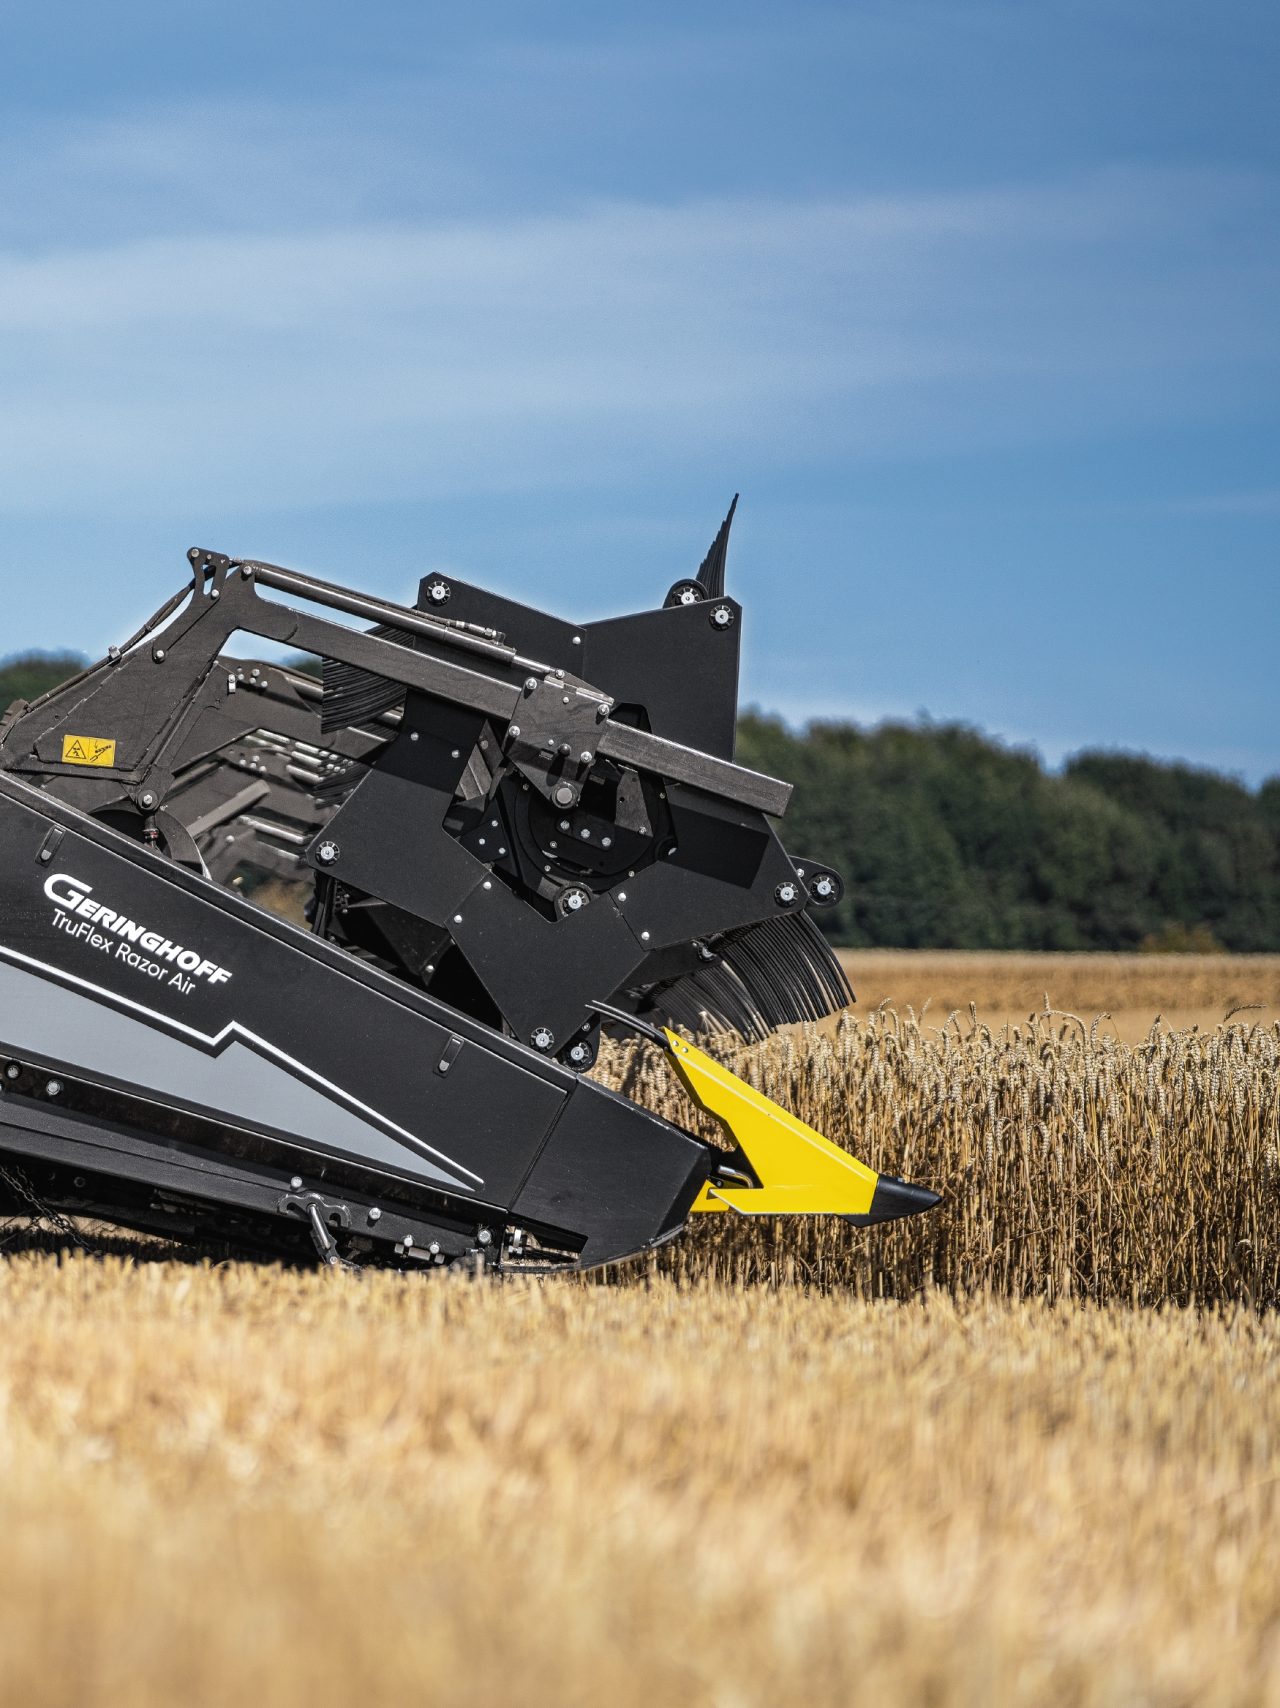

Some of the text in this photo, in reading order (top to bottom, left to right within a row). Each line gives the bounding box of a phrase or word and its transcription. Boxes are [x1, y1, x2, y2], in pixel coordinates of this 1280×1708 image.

[43, 873, 233, 984] GERINGHOFF
[52, 908, 195, 995] TruFlex Razor Air
